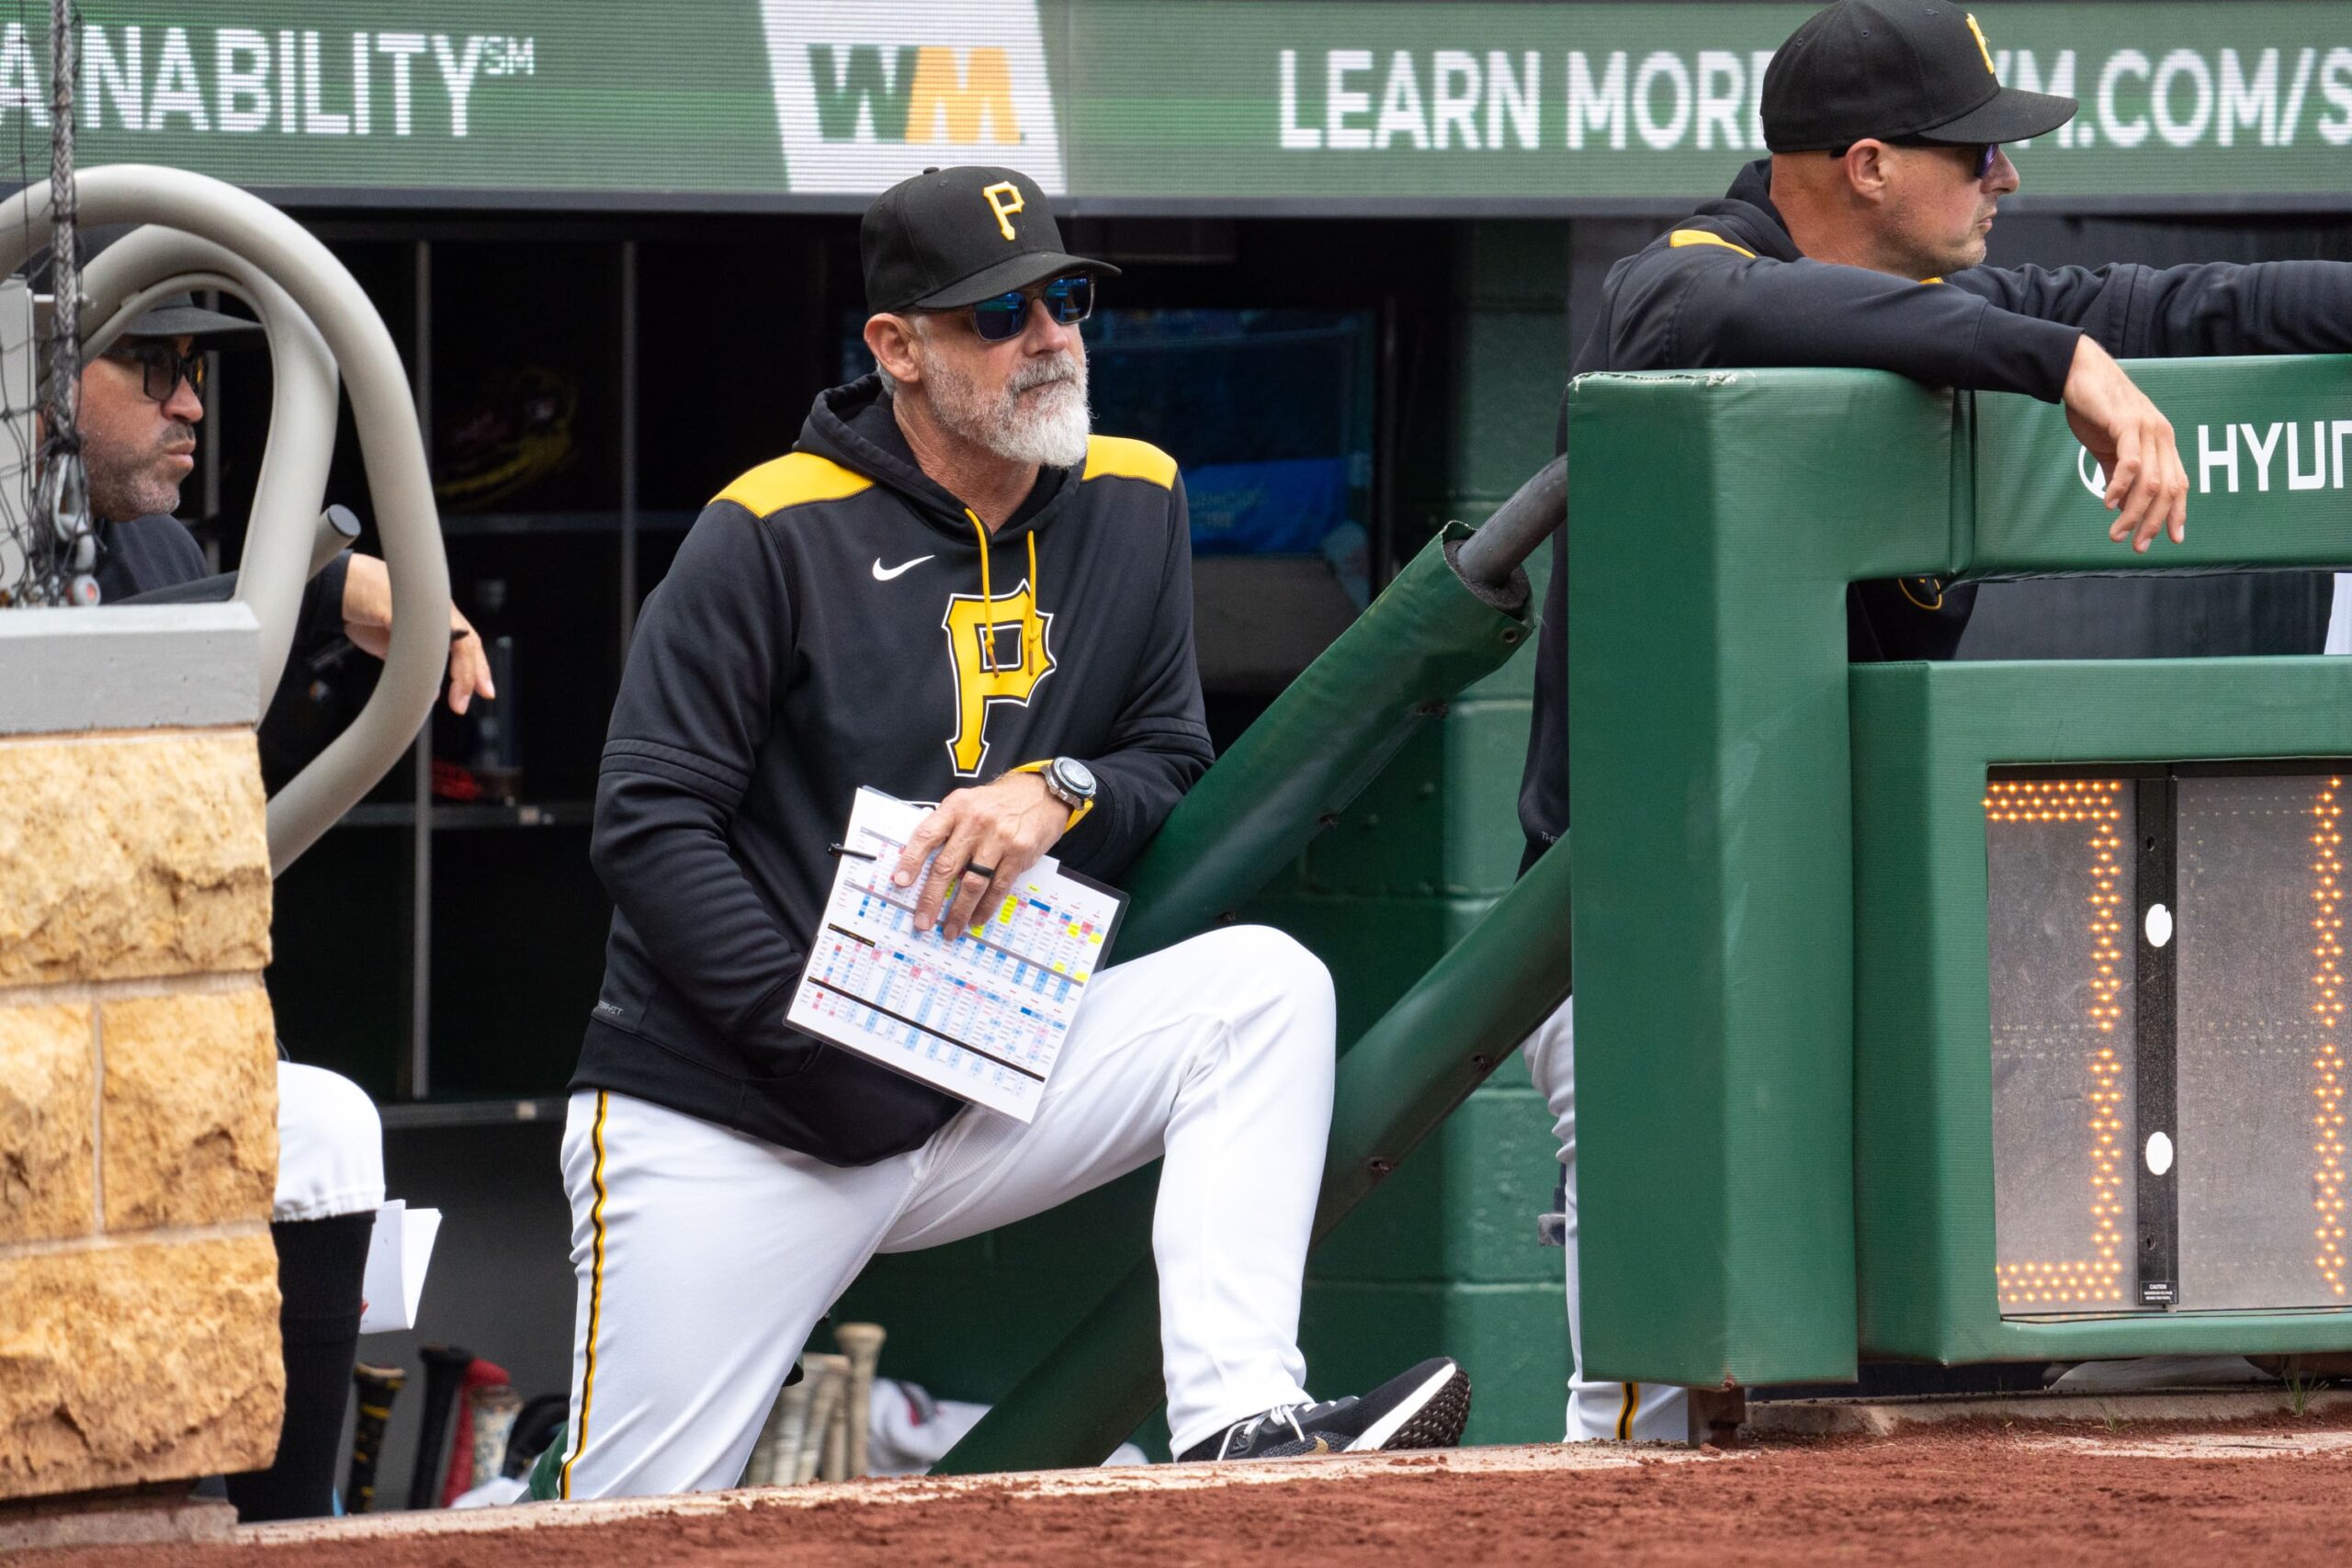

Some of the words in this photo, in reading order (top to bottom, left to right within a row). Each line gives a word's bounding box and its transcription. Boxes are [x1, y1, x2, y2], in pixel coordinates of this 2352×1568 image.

[808, 44, 1021, 143] WM
[1280, 50, 1541, 150] LEARN
[983, 181, 1024, 241] P
[942, 578, 1057, 778] P
